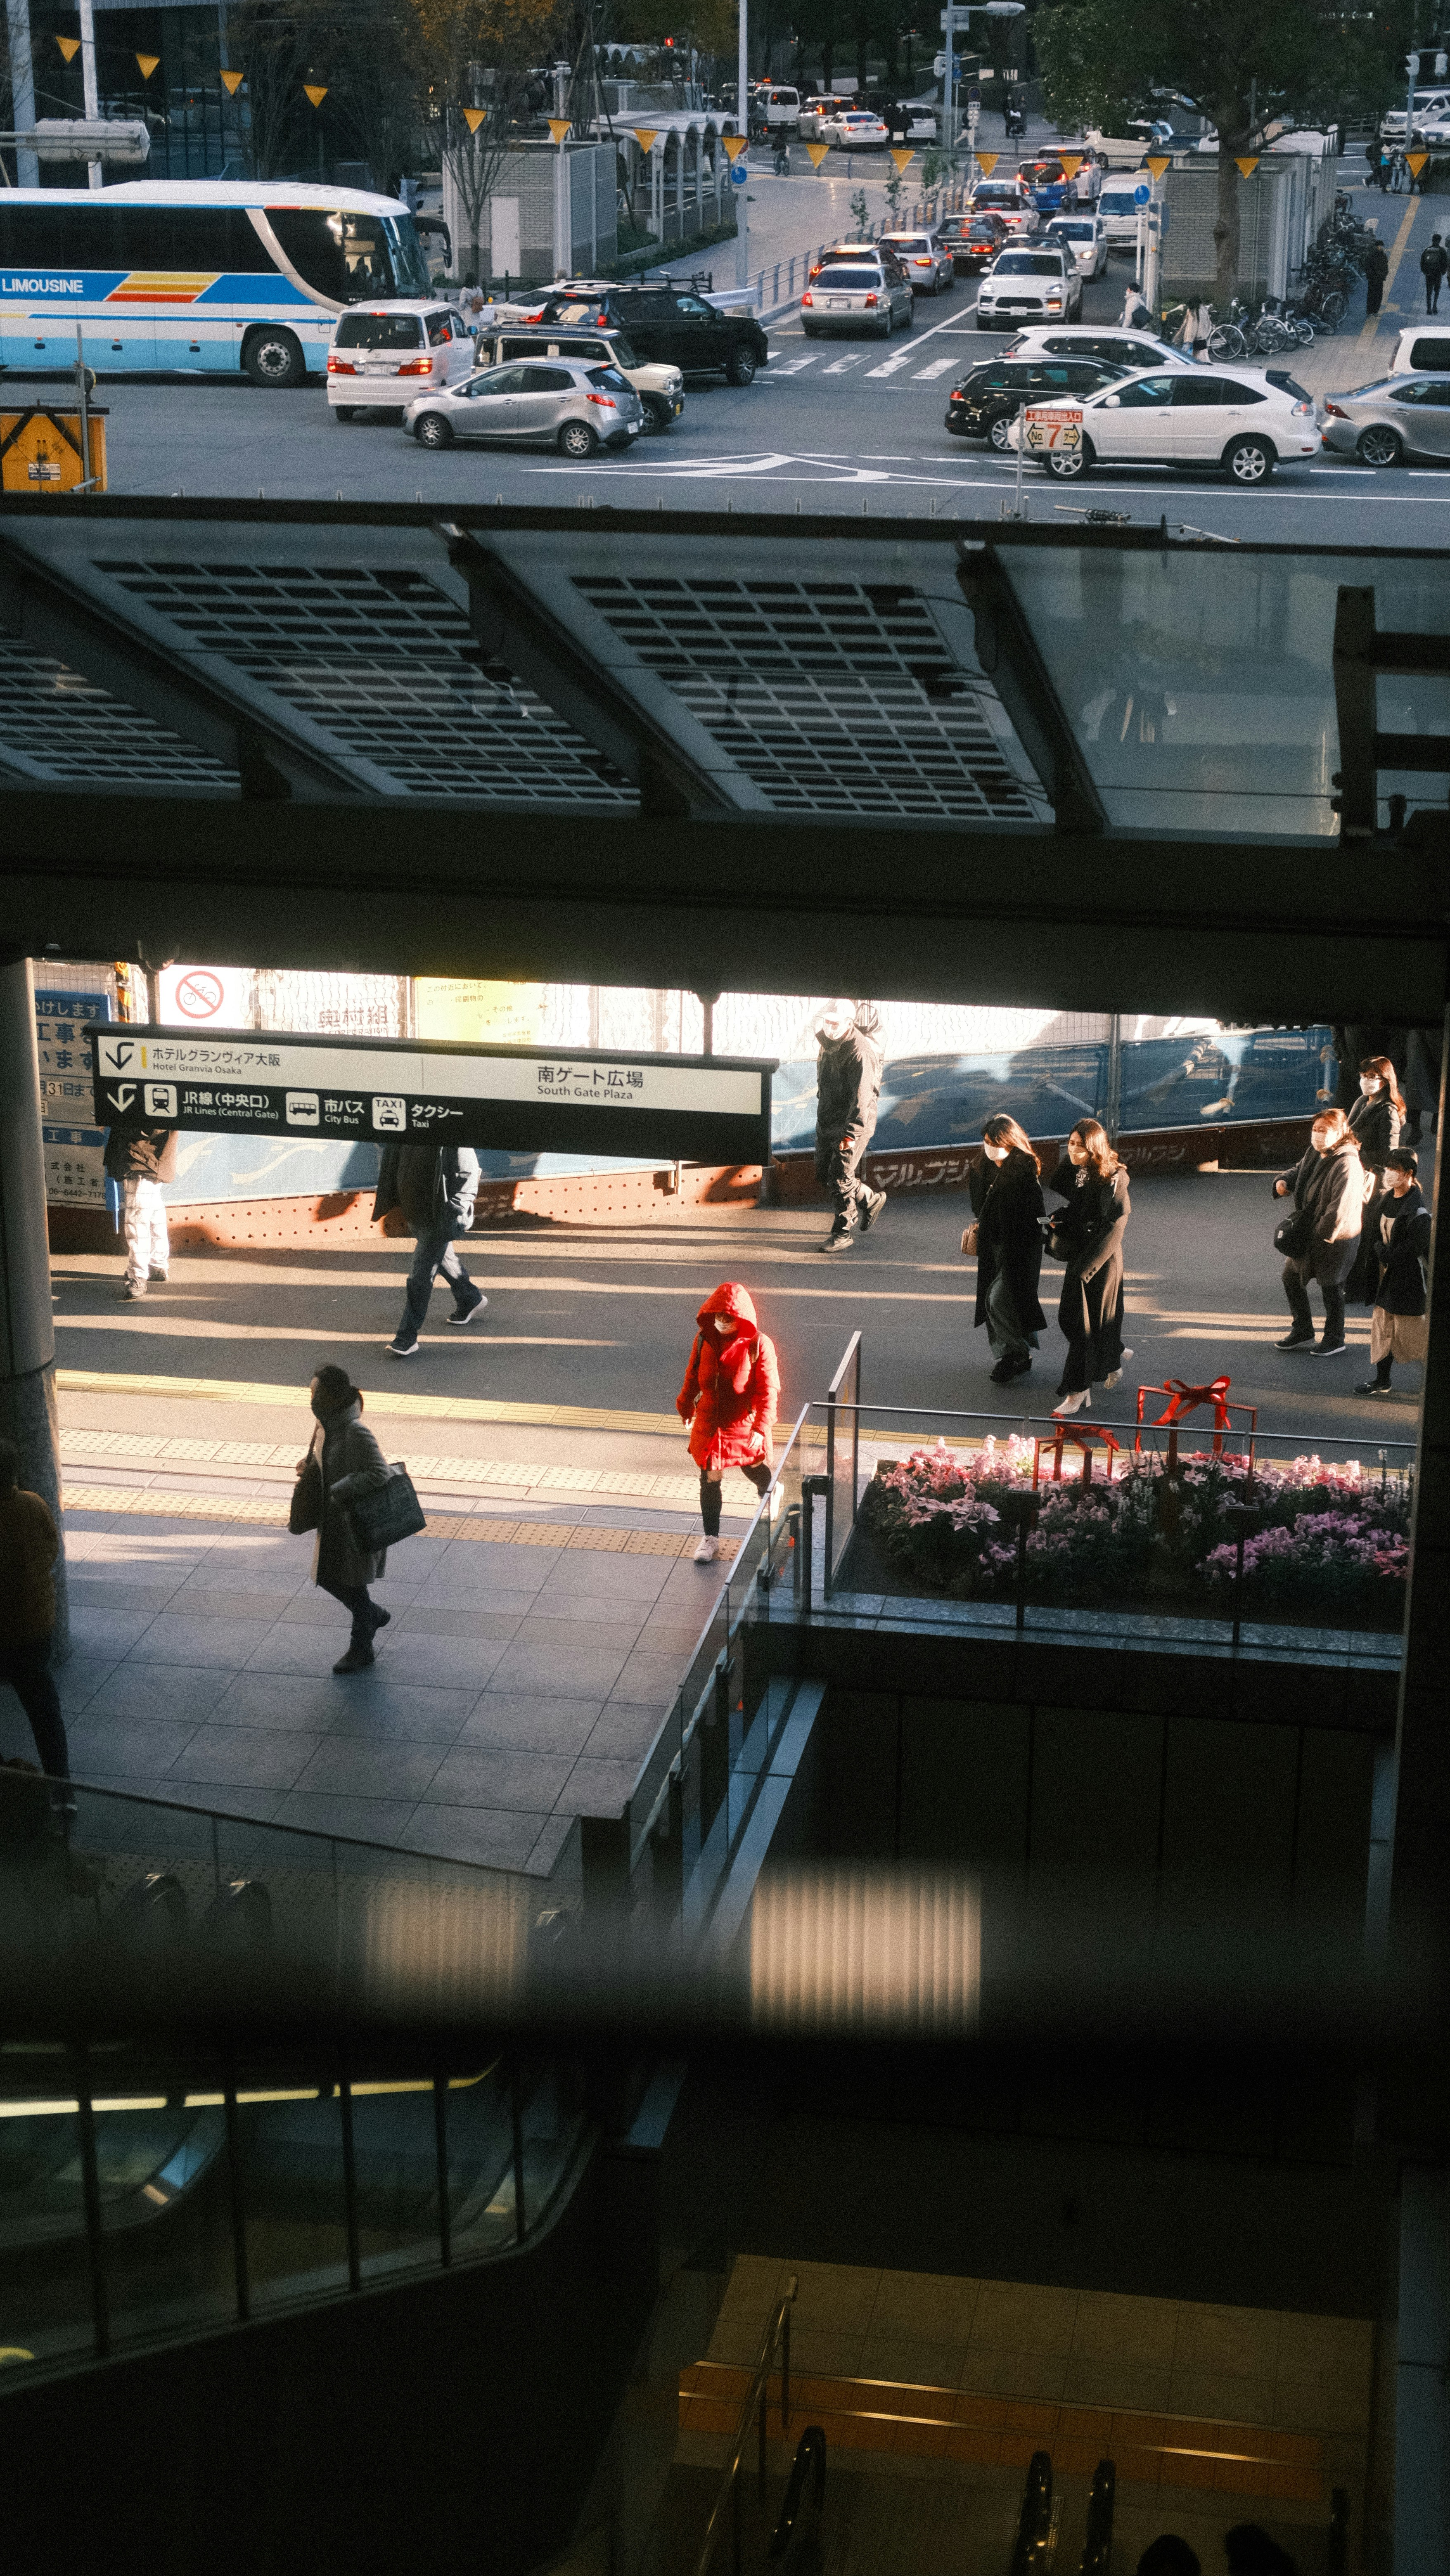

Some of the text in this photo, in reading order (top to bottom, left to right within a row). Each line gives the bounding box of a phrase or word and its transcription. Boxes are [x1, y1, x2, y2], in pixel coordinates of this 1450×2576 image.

[2, 278, 83, 293] LIMOUSINE
[1047, 424, 1061, 447] 7
[153, 1047, 281, 1066] ホテルグランヴィア大阪
[179, 1064, 212, 1073] Granvia
[538, 1066, 644, 1088] 南ゲート広場
[538, 1085, 633, 1100] South Gate Plaza
[324, 1099, 365, 1114] 市バス
[375, 1099, 403, 1108] TAXI
[194, 1106, 216, 1115] Lines
[218, 1108, 253, 1118] (Central
[254, 1110, 279, 1120] Gate)
[411, 1104, 464, 1118] タクシー
[325, 1114, 359, 1125] City Bus
[411, 1119, 429, 1128] Taxi
[48, 1129, 82, 1144] 工事
[44, 1161, 85, 1172] 式会社
